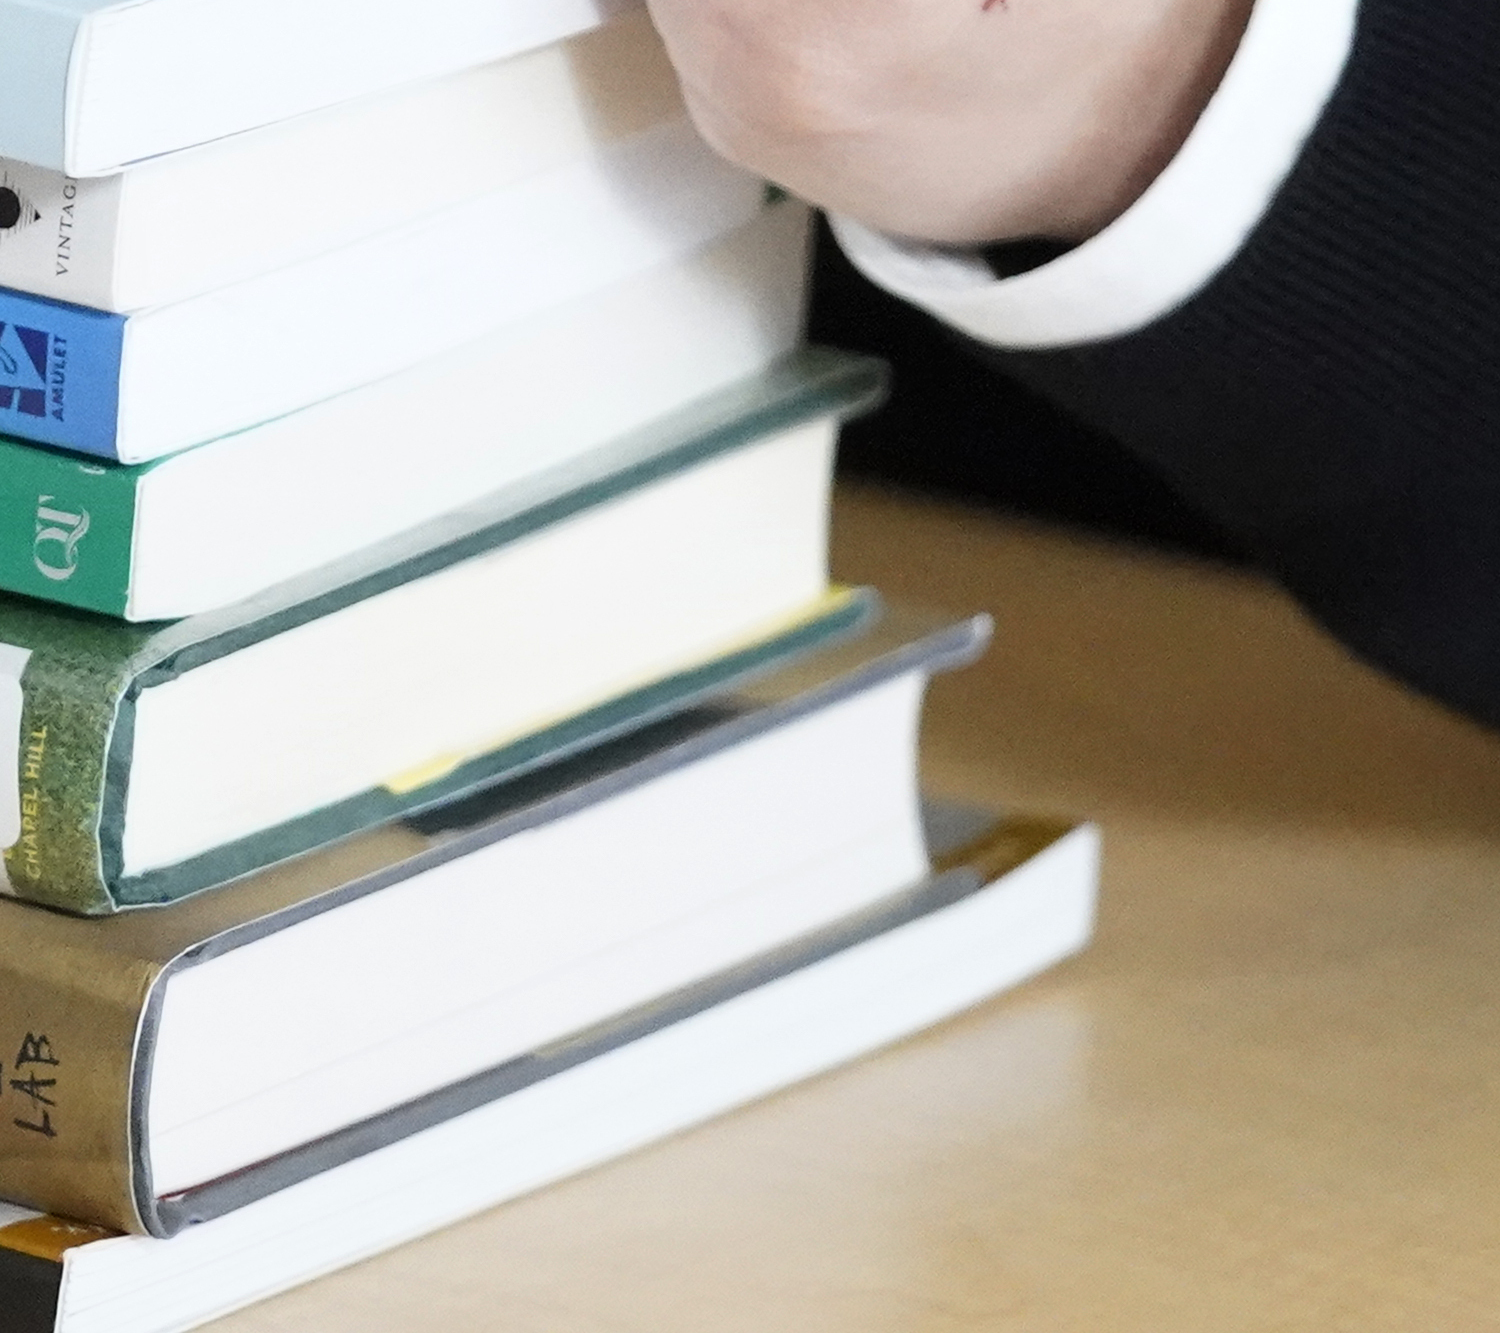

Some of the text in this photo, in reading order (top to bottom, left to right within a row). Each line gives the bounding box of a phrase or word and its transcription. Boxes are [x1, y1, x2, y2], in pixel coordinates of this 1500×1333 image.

[56, 176, 79, 277] VINTAG
[52, 334, 68, 422] AMULET
[22, 725, 47, 880] CHAPEL HILL
[10, 1031, 60, 1138] LAB
